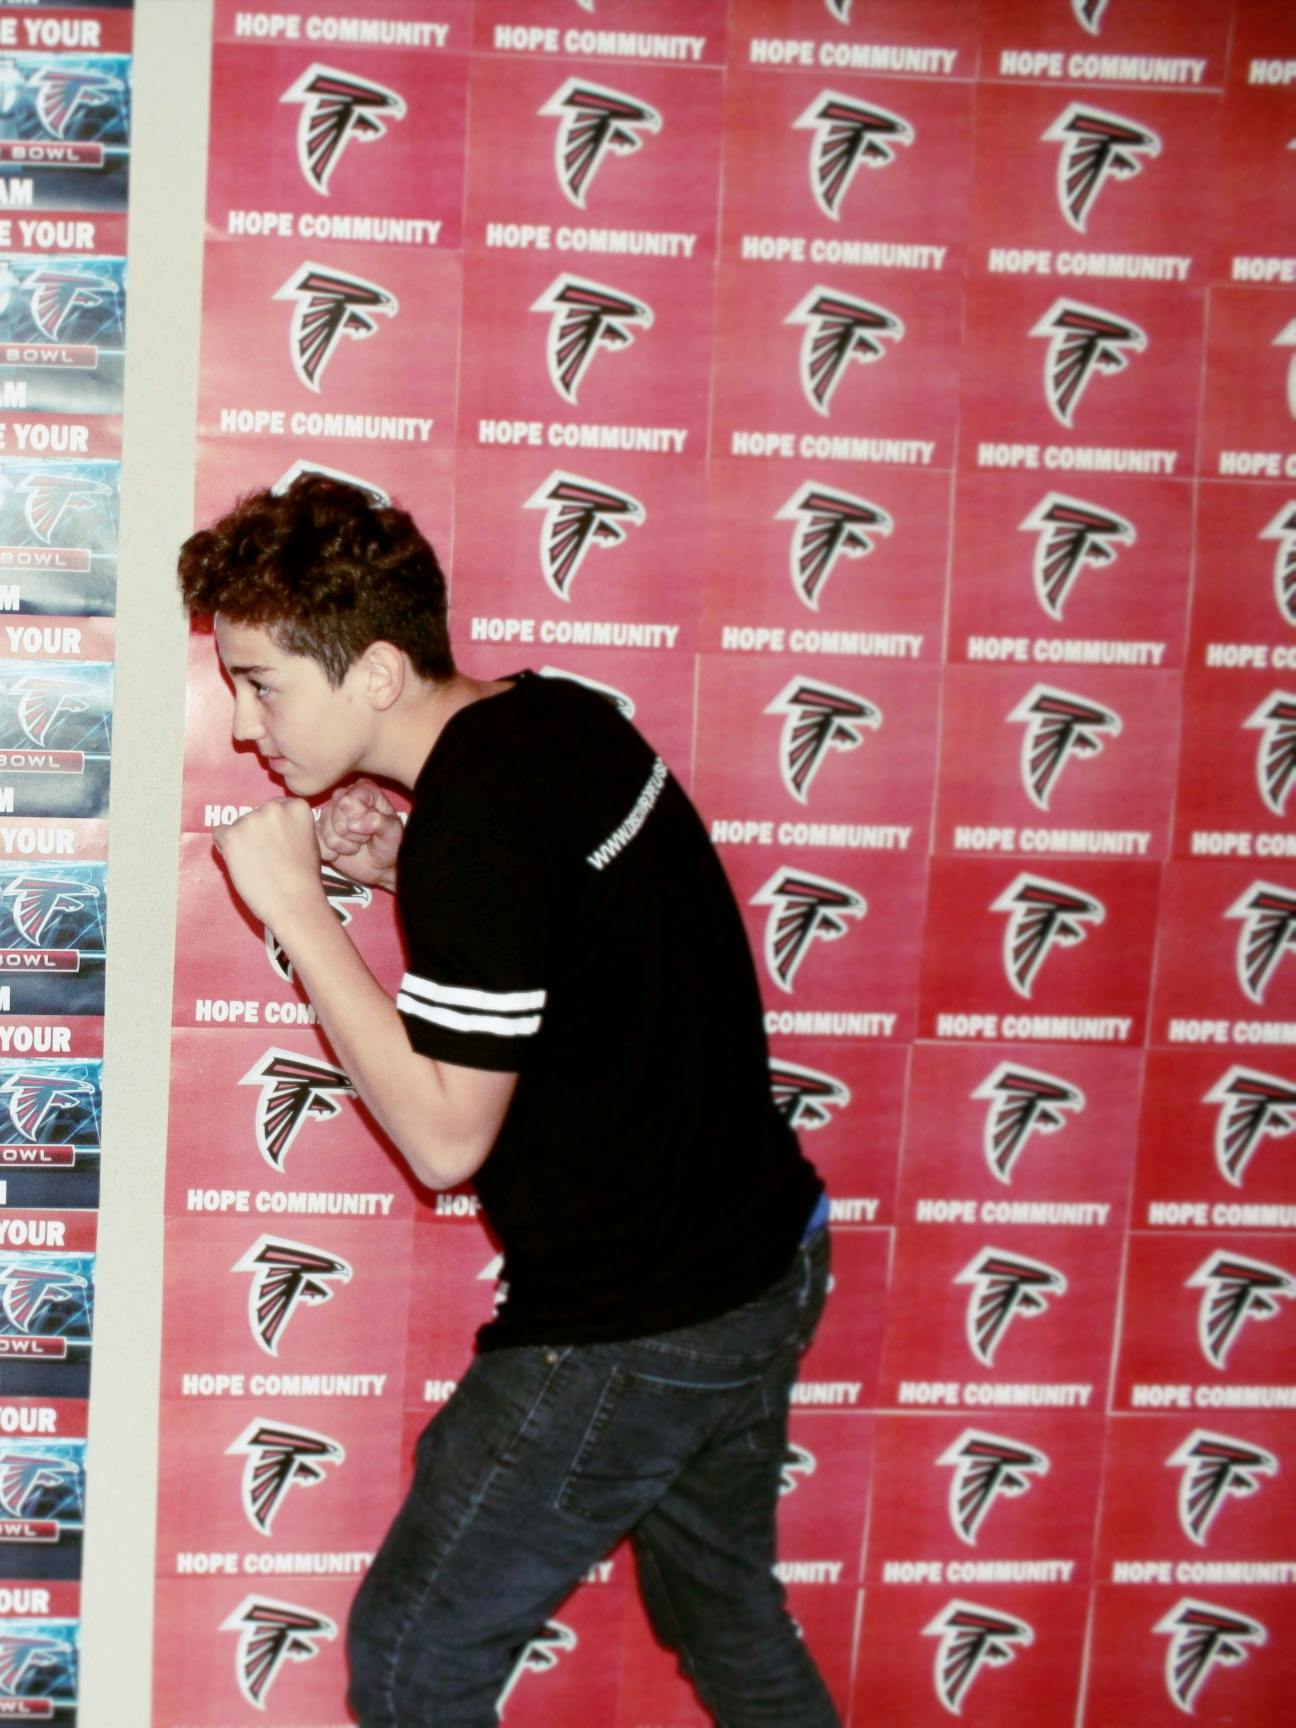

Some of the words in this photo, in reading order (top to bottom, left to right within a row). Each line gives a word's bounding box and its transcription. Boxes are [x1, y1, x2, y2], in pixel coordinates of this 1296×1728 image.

[24, 19, 101, 47] YOUR
[235, 13, 300, 38] HOPE
[306, 17, 449, 47] COMMUNITY
[495, 26, 558, 51] HOPE
[564, 30, 705, 60] COMMUNITY
[750, 40, 814, 64] HOPE
[819, 43, 957, 73] COMMUNITY
[1001, 51, 1064, 77] HOPE
[1068, 54, 1206, 82] COMMUNITY
[1249, 59, 1296, 86] HOP
[14, 146, 80, 161] BOWL
[18, 221, 95, 248] YOUR
[229, 211, 292, 236] HOPE
[299, 214, 442, 244] COMMUNITY
[486, 224, 550, 249] HOPE
[556, 227, 696, 257] COMMUNITY
[742, 236, 805, 261] HOPE
[810, 240, 946, 269] COMMUNITY
[989, 249, 1052, 274] HOPE
[1055, 252, 1191, 280] COMMUNITY
[6, 349, 74, 363] BOWL
[14, 424, 89, 451] YOUR
[222, 411, 284, 432] HOPE
[292, 414, 432, 441] COMMUNITY
[479, 420, 543, 445] HOPE
[548, 424, 687, 452] COMMUNITY
[732, 432, 795, 457] HOPE
[800, 435, 935, 463] COMMUNITY
[978, 443, 1040, 468] HOPE
[1043, 446, 1177, 473] COMMUNITY
[1219, 451, 1282, 476] HOPE
[0, 551, 67, 566] BOWL
[7, 627, 81, 654] YOUR
[471, 618, 535, 641] HOPE
[540, 621, 679, 648] COMMUNITY
[722, 627, 784, 651] HOPE
[789, 630, 923, 657] COMMUNITY
[968, 637, 1029, 661] HOPE
[1032, 639, 1166, 665] COMMUNITY
[1206, 644, 1269, 668] HOPE
[205, 805, 252, 826] HOP
[0, 828, 75, 855] YOUR
[711, 820, 774, 844] HOPE
[778, 823, 912, 849] COMMUNITY
[954, 827, 1015, 850] HOPE
[1019, 829, 1151, 854] COMMUNITY
[1191, 831, 1253, 856] HOPE
[196, 1000, 259, 1022] HOPE
[764, 1010, 897, 1036] COMMUNITY
[937, 1014, 999, 1038] HOPE
[1001, 1015, 1132, 1040] COMMUNITY
[1168, 1019, 1230, 1043] HOPE
[187, 1189, 250, 1211] HOPE
[256, 1191, 394, 1215] COMMUNITY
[915, 1199, 978, 1223] HOPE
[980, 1201, 1110, 1225] COMMUNITY
[1148, 1202, 1210, 1226] HOPE
[1210, 1203, 1296, 1227] COMMU
[183, 1374, 244, 1395] HOPE
[250, 1375, 386, 1395] COMMUNITY
[898, 1382, 961, 1405] HOPE
[962, 1383, 1093, 1406] COMMUNITY
[1132, 1385, 1193, 1408] HOPE
[177, 1553, 238, 1573] HOPE
[882, 1561, 944, 1584] HOPE
[944, 1560, 1075, 1583] COMMUNITY
[1112, 1561, 1174, 1584] HOPE
